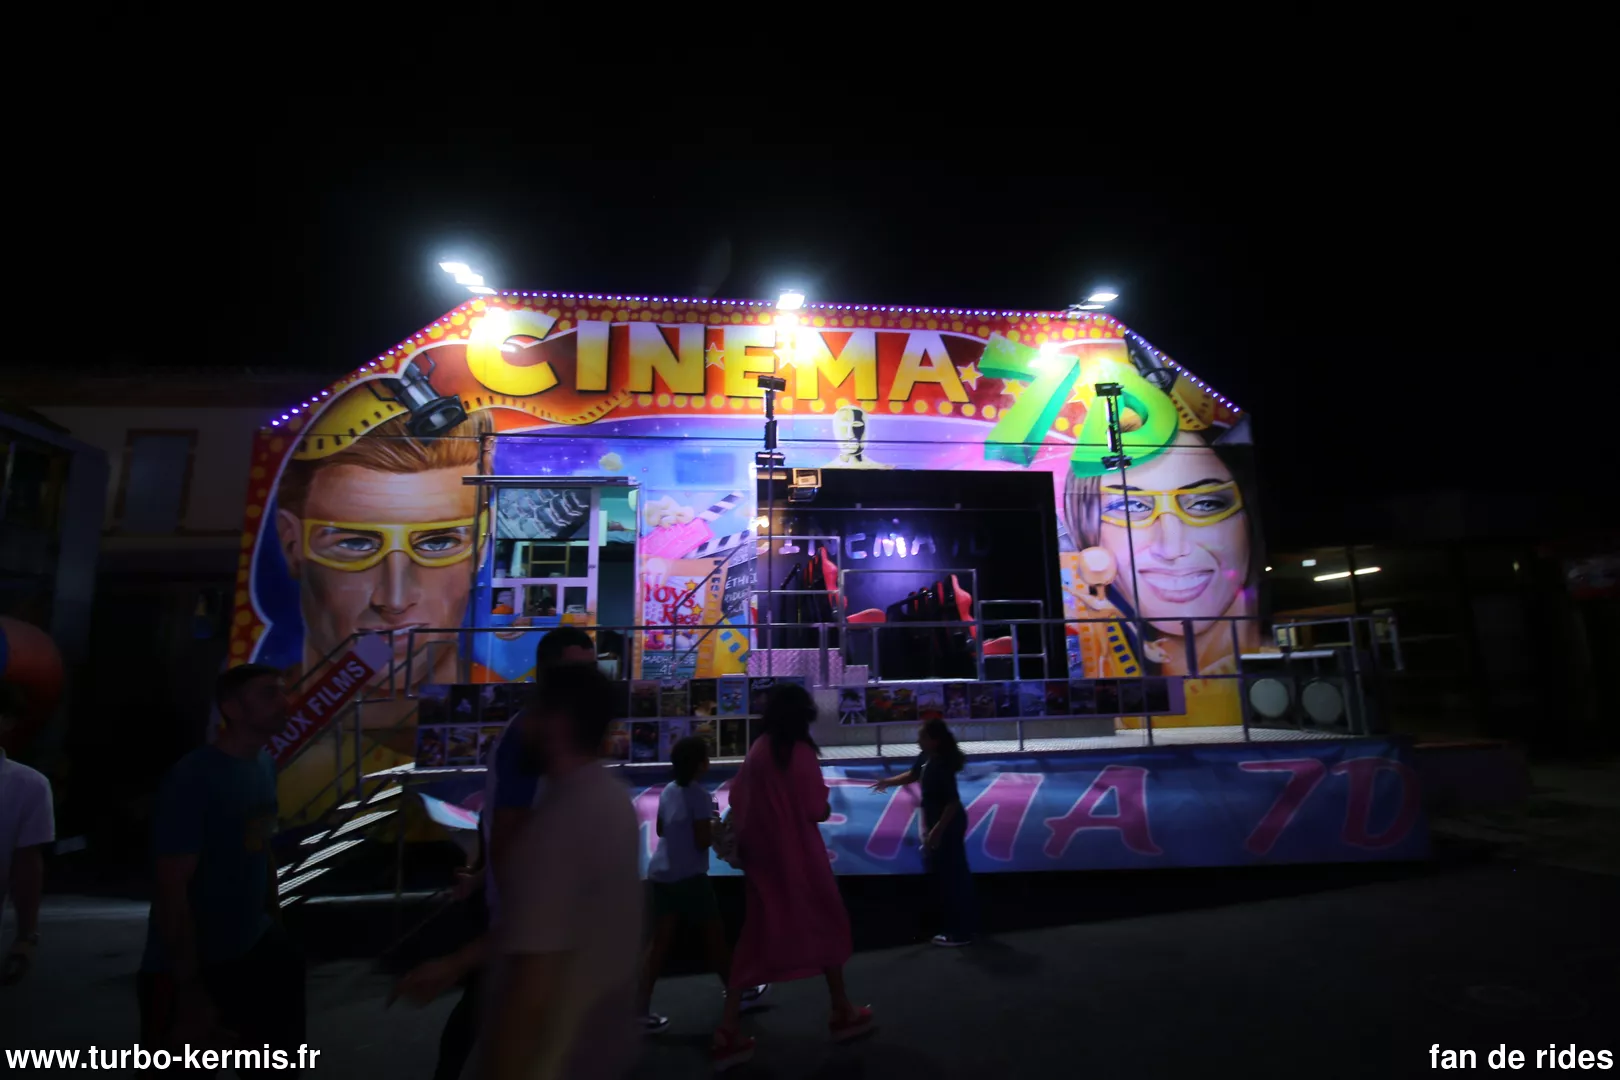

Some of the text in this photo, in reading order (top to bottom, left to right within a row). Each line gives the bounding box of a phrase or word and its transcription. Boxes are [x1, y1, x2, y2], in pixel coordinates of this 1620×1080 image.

[466, 308, 1180, 479] CINEMA 7D
[259, 660, 368, 760] EAUX FILMS
[1237, 756, 1422, 856] 7D
